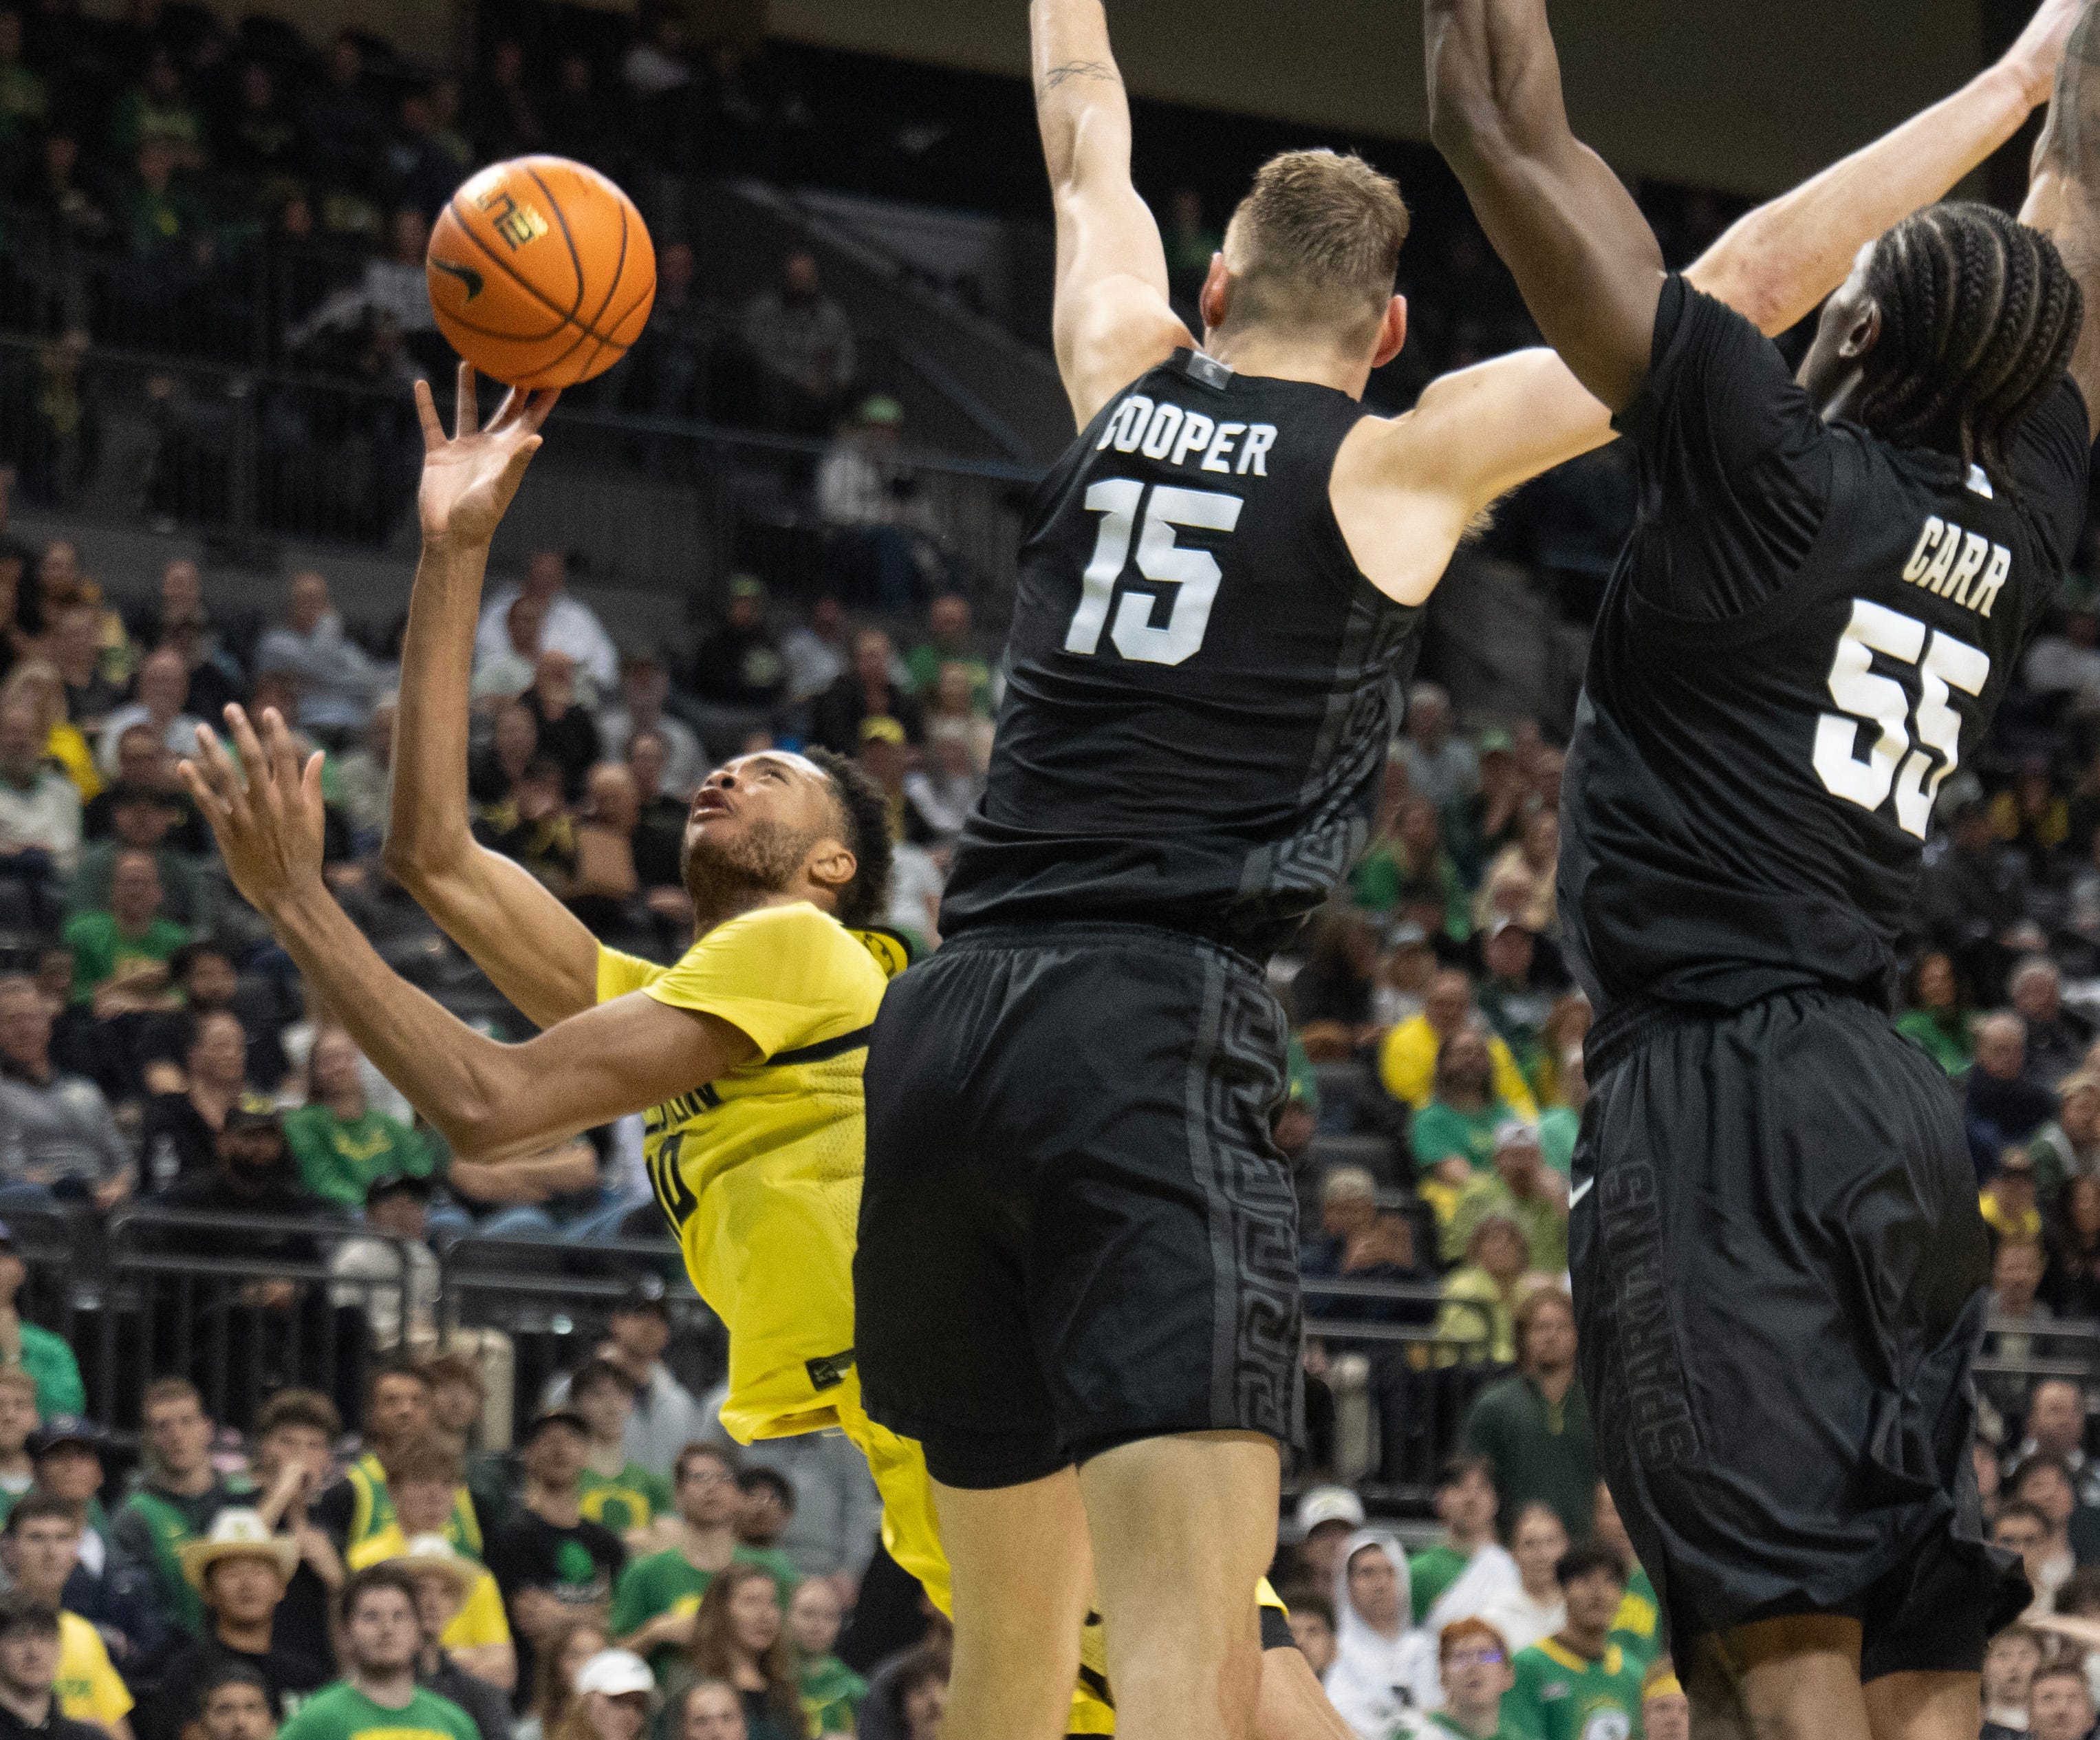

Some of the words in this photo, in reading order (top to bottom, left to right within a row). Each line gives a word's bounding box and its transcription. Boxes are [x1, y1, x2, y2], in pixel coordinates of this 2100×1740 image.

[1096, 395, 1279, 477] COOPER
[1064, 478, 1245, 666] 15
[1902, 515, 2012, 619] CARR
[1812, 598, 1991, 841] 55
